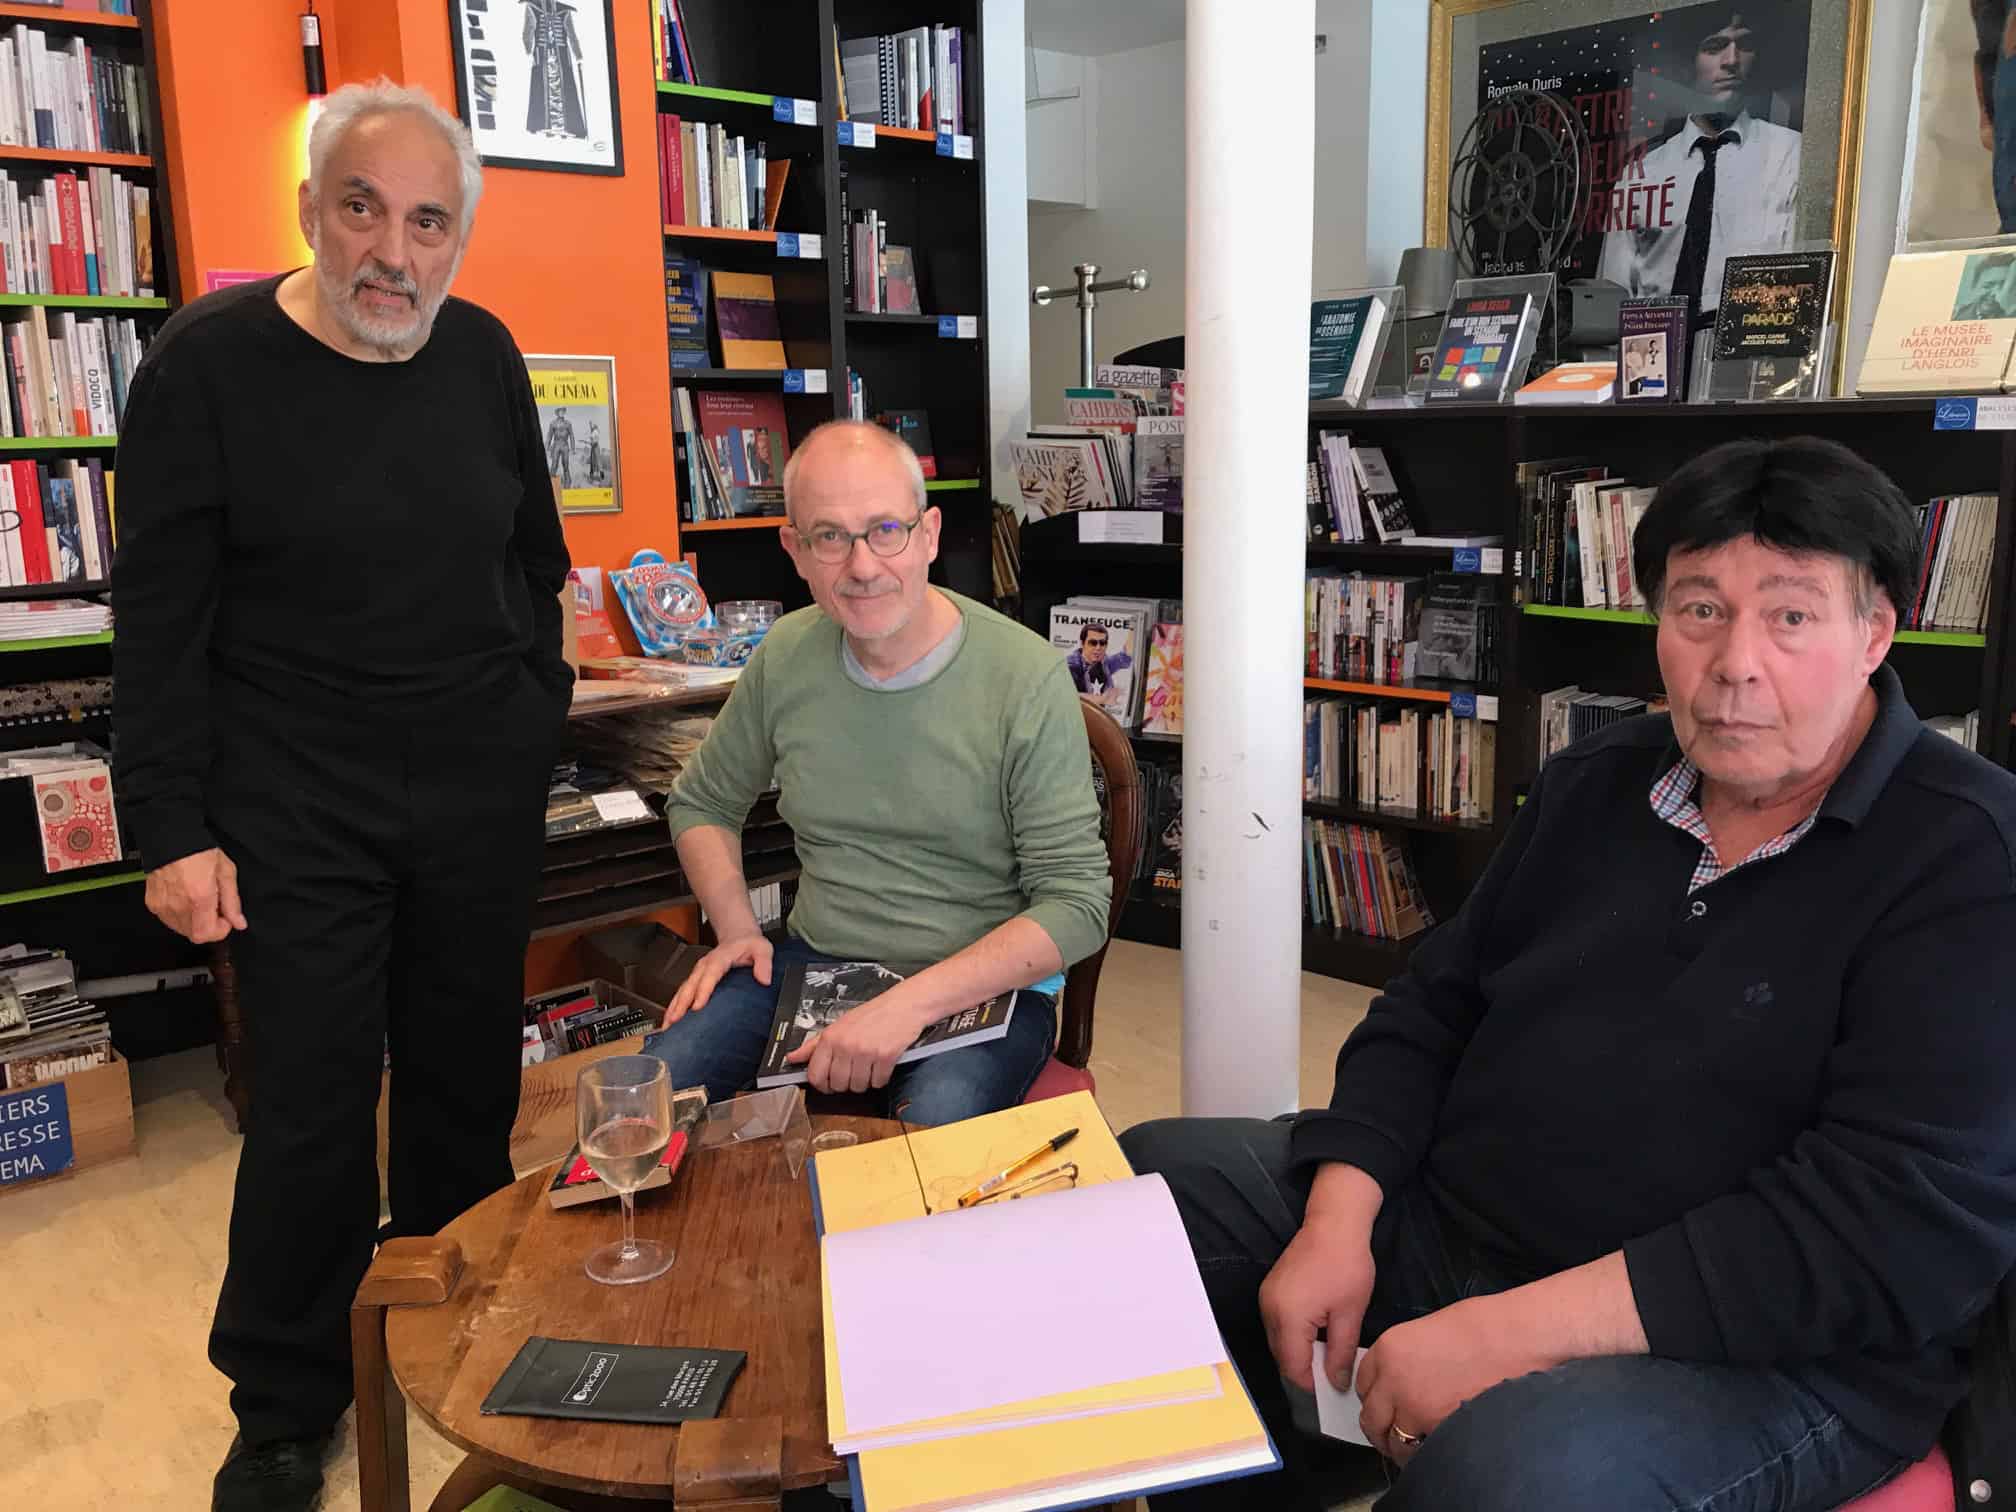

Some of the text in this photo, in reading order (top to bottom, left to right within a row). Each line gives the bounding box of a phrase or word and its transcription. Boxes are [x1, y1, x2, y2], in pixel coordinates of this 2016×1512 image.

[1487, 75, 1563, 100] Romain Duris
[1912, 322, 1987, 338] LE MUSÉE
[1901, 335, 1993, 349] IMAGINAIRE
[1912, 348, 1976, 360] D'HENRI
[1901, 357, 1980, 372] LANGLOIS
[1096, 367, 1161, 388] La gazette
[1147, 419, 1185, 434] POSI
[1, 1153, 46, 1181] EMA
